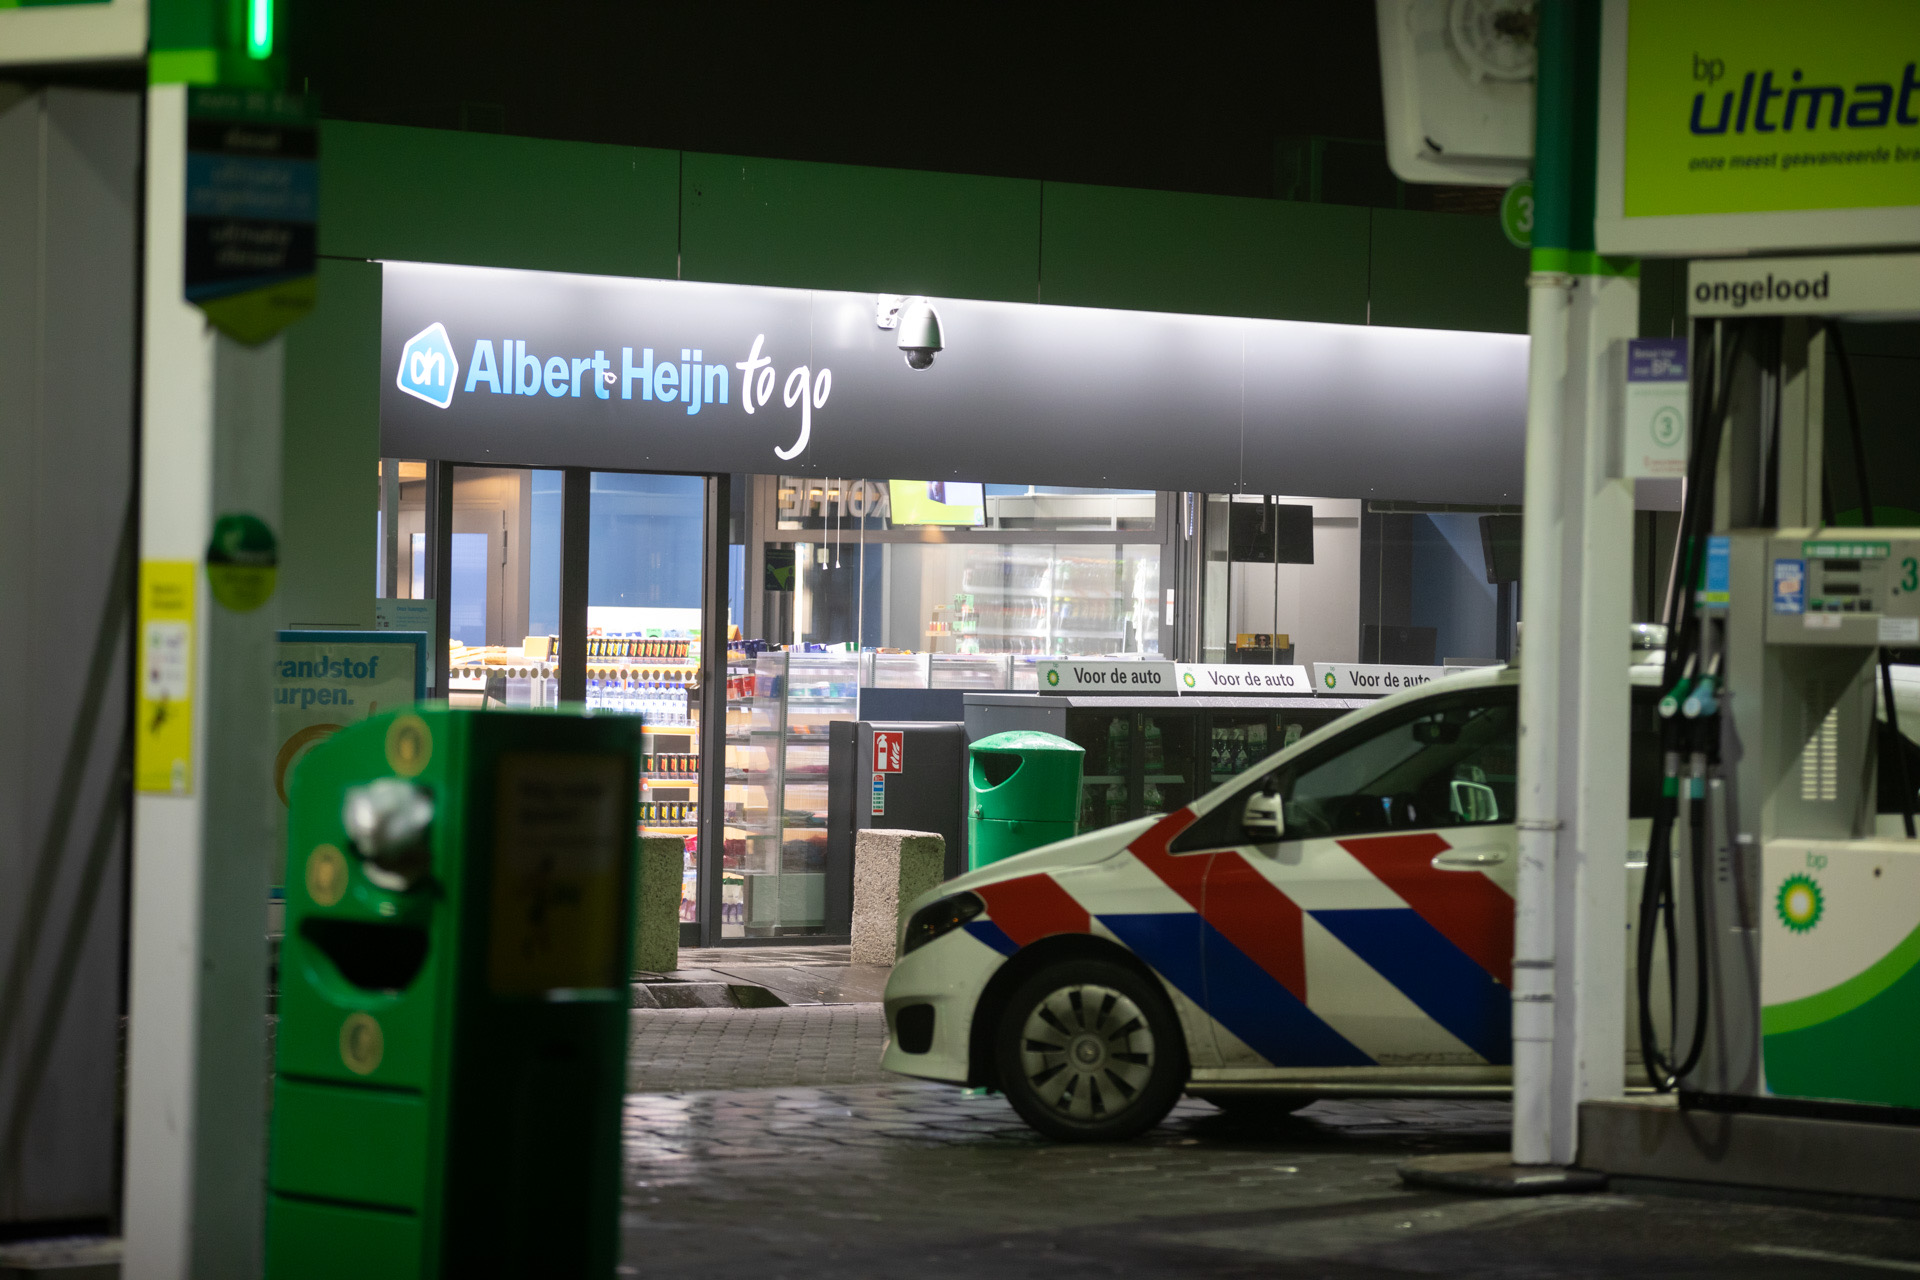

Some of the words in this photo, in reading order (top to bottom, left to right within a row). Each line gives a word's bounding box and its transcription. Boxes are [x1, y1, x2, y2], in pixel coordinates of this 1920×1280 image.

[1693, 52, 1725, 86] bp
[1517, 195, 1535, 233] 3
[1695, 271, 1829, 308] ongelood
[464, 338, 611, 400] Albert
[621, 346, 729, 416] Heijn
[735, 333, 776, 415] to
[774, 364, 832, 461] go
[1661, 416, 1673, 438] 3
[1902, 556, 1919, 592] 3
[1073, 667, 1106, 684] Voor
[1110, 668, 1127, 684] de
[1131, 669, 1161, 685] auto
[1207, 670, 1240, 686] Voor
[1244, 671, 1261, 686] de
[1265, 673, 1294, 687] auto
[1349, 670, 1380, 687] Voor
[1384, 671, 1400, 687] de
[1806, 849, 1828, 872] bp
